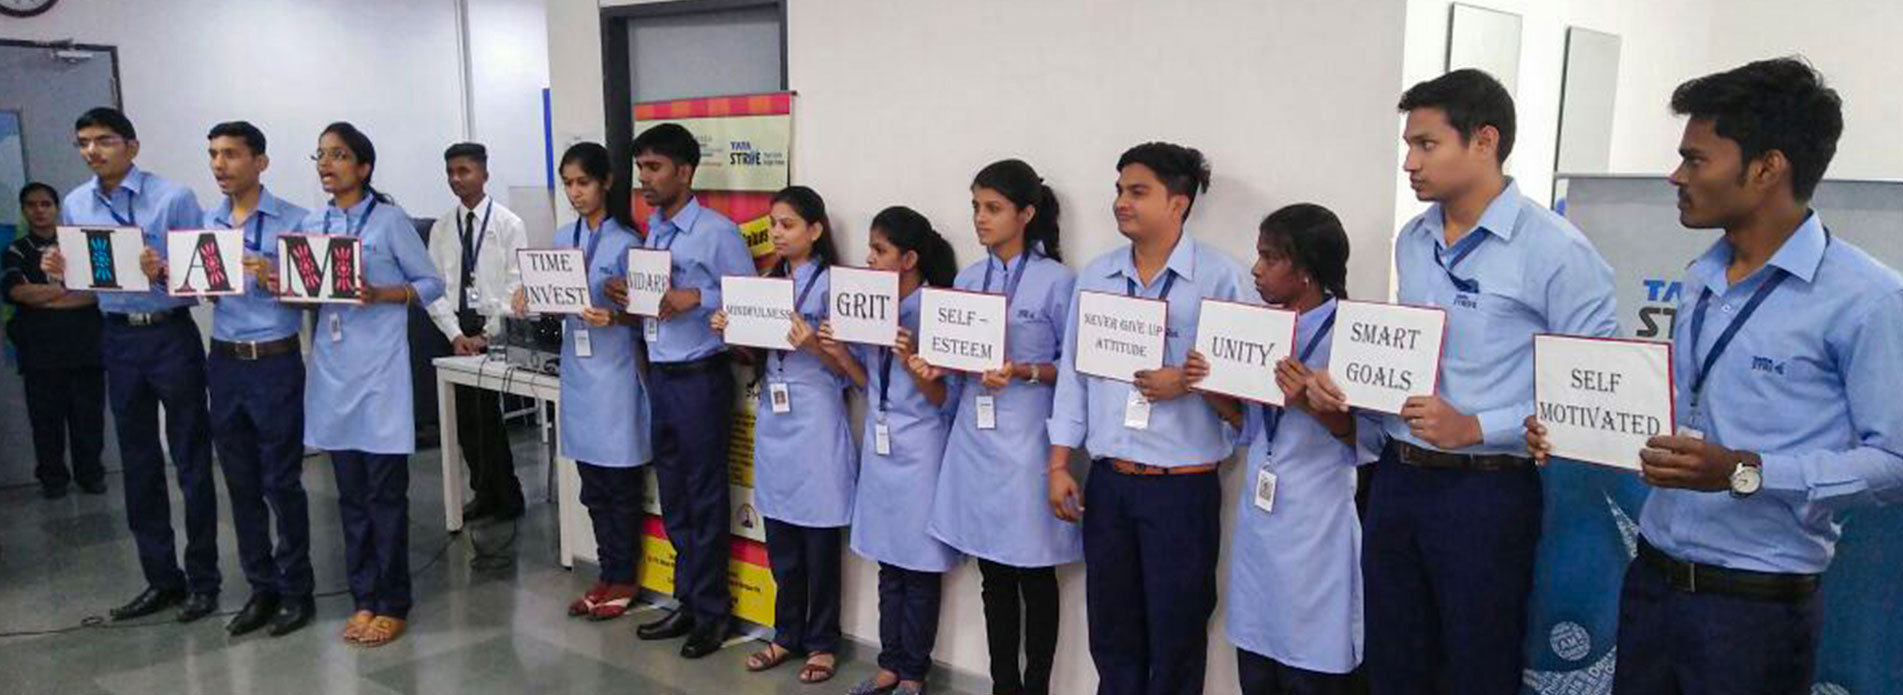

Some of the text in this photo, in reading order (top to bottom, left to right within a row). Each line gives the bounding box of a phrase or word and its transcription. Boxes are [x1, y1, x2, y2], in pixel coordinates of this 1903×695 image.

[80, 229, 357, 298] I A M
[527, 252, 573, 272] TIME
[524, 285, 587, 305] INVEST
[836, 292, 891, 321] GRIT
[726, 304, 791, 320] MINDFULNESS
[937, 307, 977, 327] SELF
[1084, 312, 1118, 330] NEVER
[1119, 320, 1145, 335] GIVE
[1149, 322, 1163, 337] UP
[932, 336, 993, 360] ESTEEM
[1095, 337, 1148, 358] ATTITUDE
[1349, 321, 1422, 350] SMART
[1212, 336, 1275, 367] UNITY
[1345, 362, 1413, 391] GOALS
[1570, 368, 1622, 393] SELF
[1539, 401, 1661, 436] MOTIVATED
